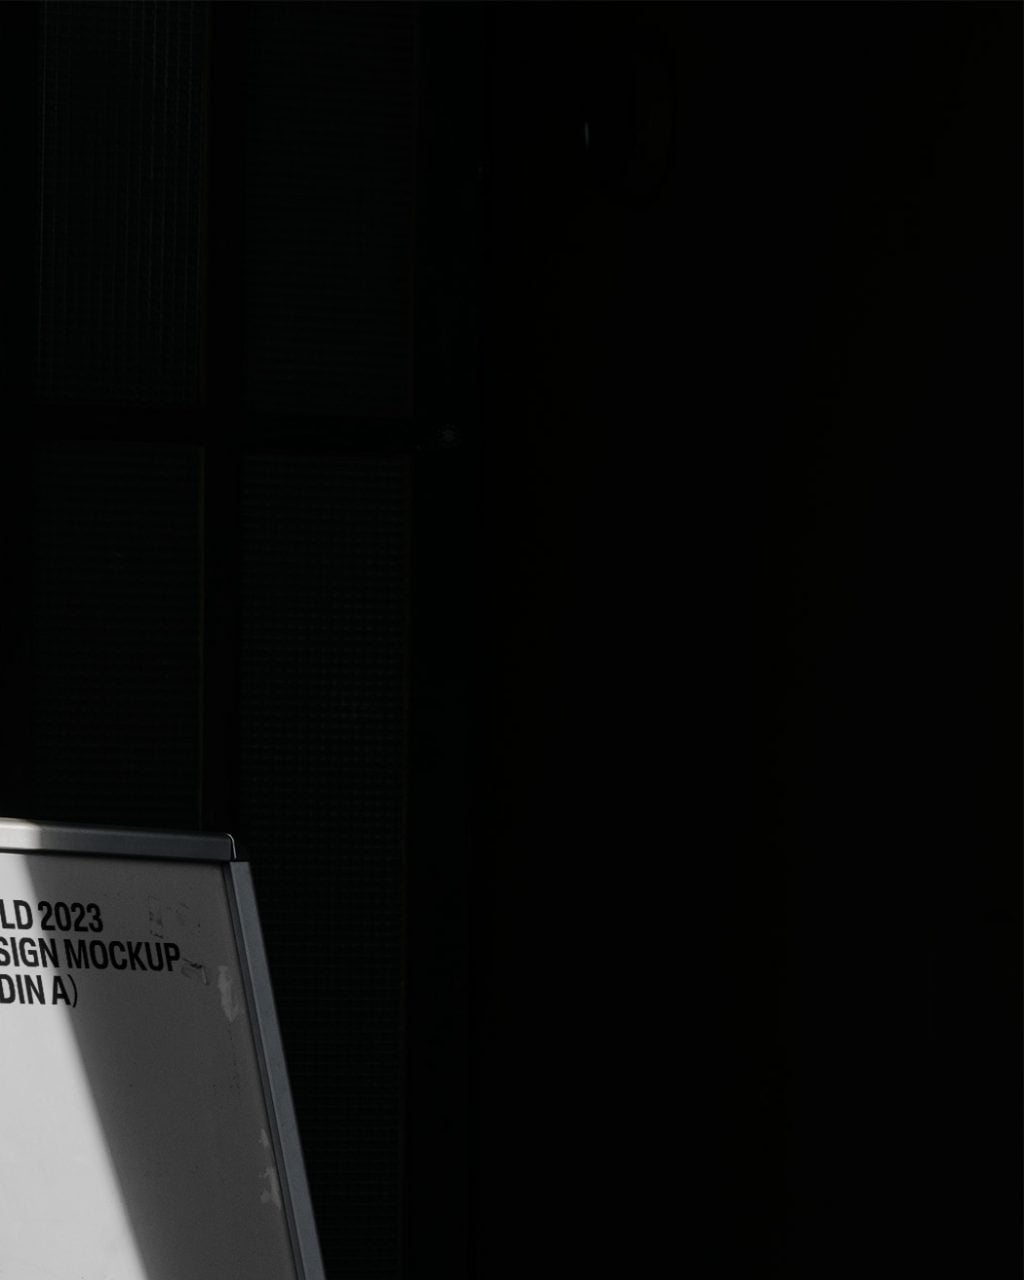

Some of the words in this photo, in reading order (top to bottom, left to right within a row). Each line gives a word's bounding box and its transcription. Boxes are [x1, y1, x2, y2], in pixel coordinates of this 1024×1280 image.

[37, 900, 104, 933] 2023
[63, 939, 181, 972] MOCKUP
[51, 974, 78, 1008] A)
